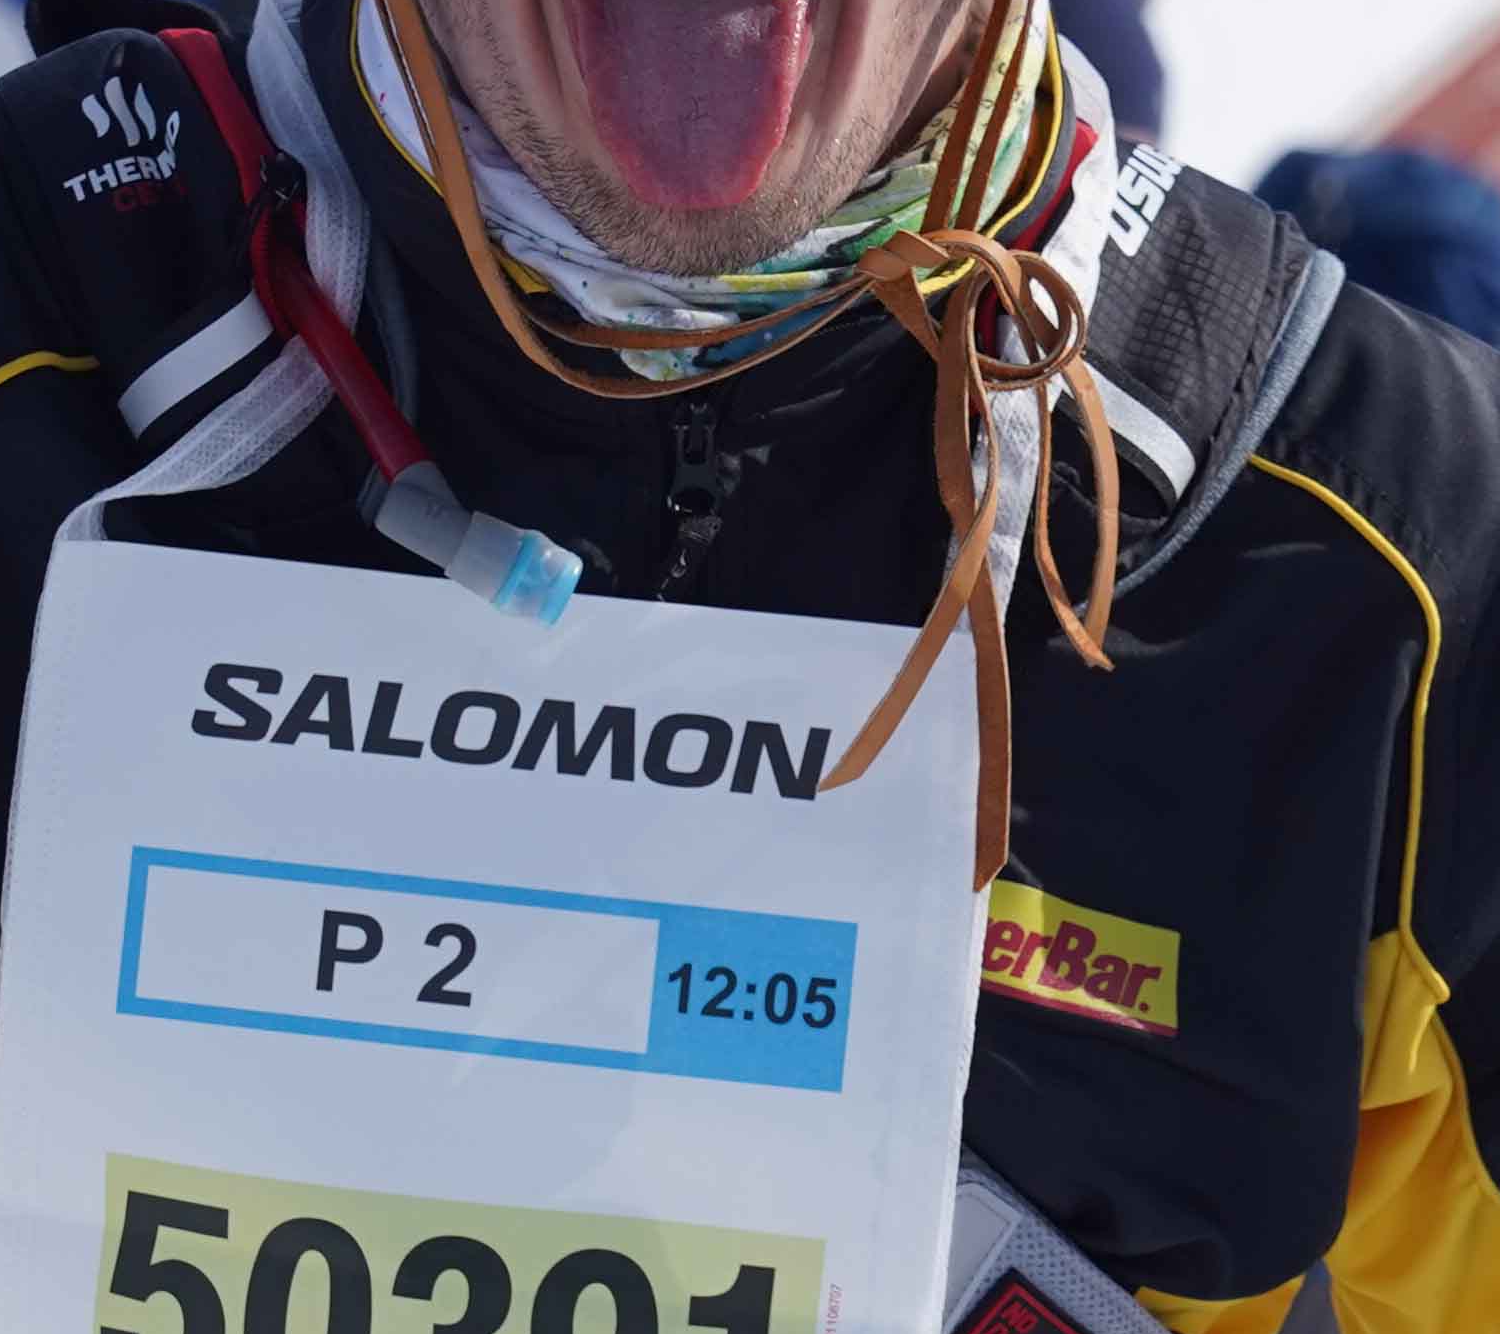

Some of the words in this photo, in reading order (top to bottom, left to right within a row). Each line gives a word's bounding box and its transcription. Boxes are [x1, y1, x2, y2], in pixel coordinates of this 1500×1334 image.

[191, 663, 832, 801] SALOMON
[315, 909, 384, 992] P
[416, 922, 477, 1008] 2
[667, 961, 837, 1030] 12:05
[1002, 1301, 1040, 1334] NO
